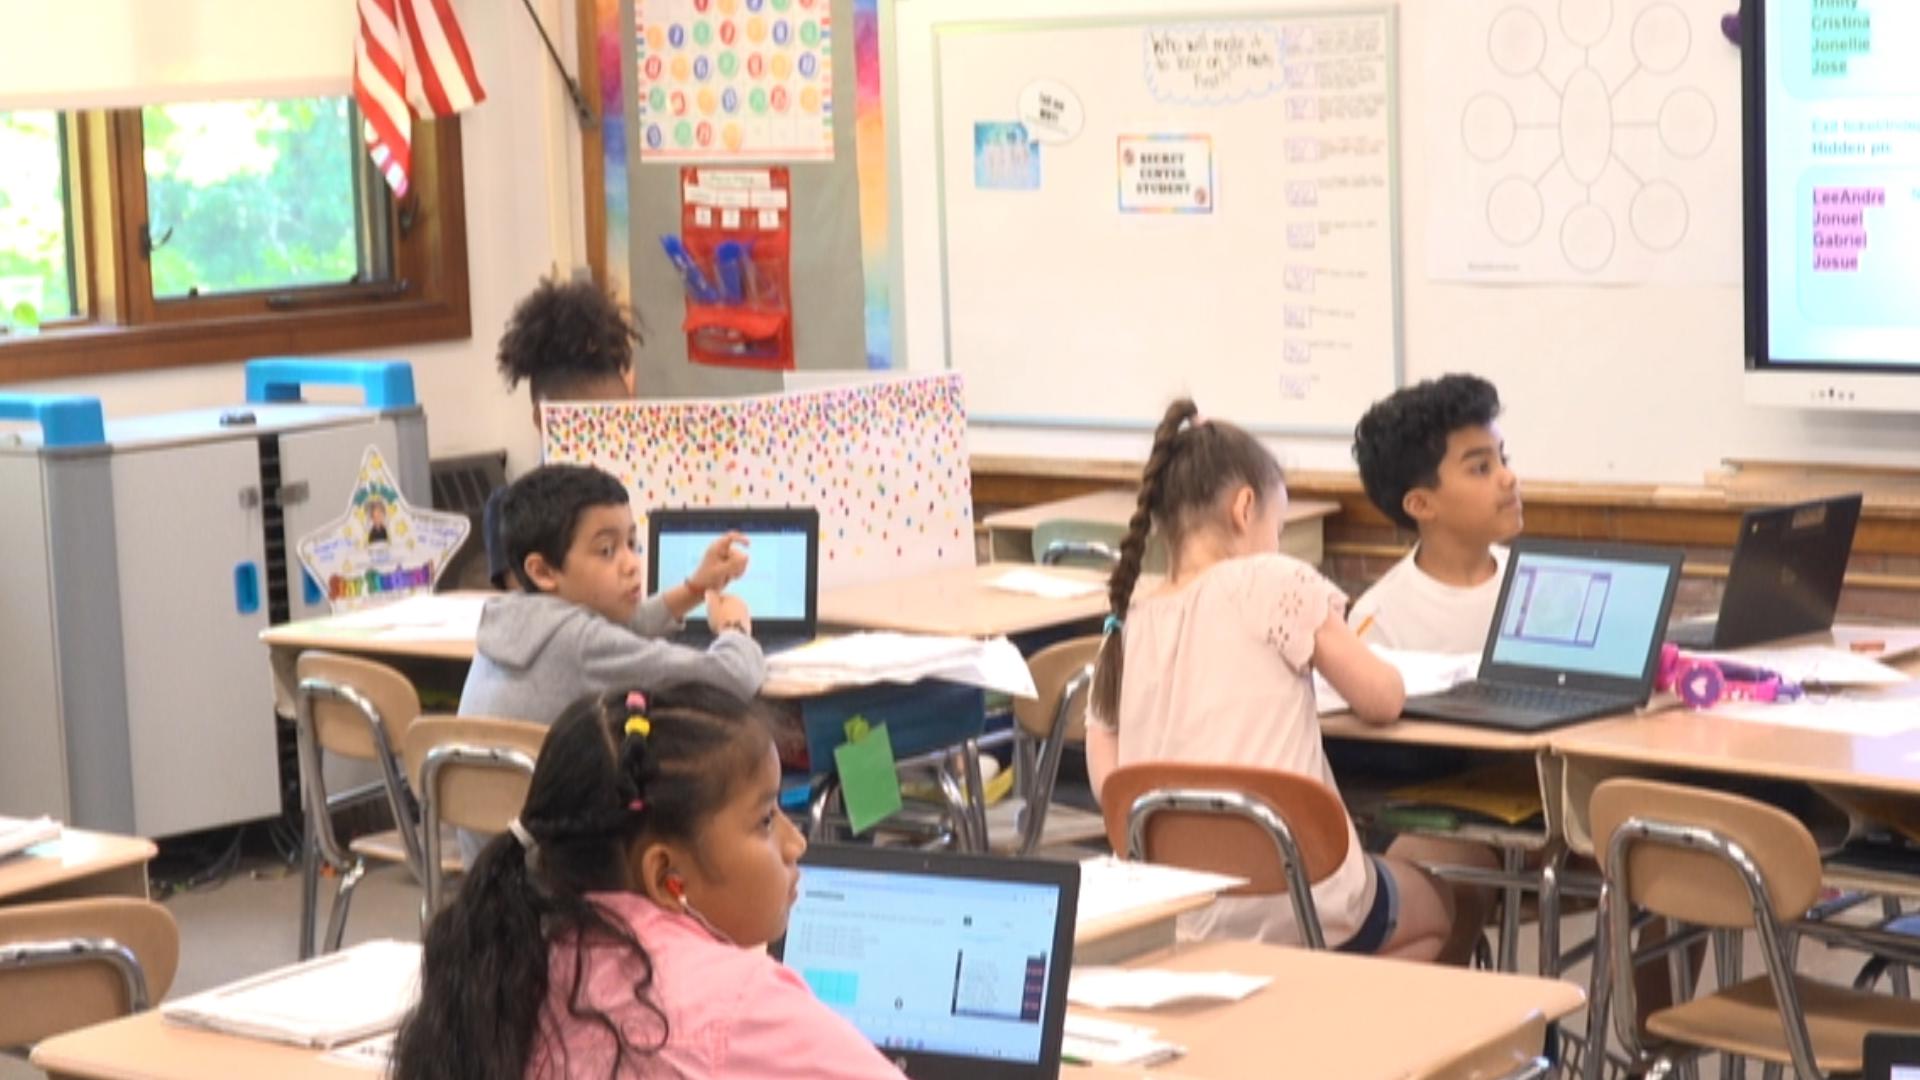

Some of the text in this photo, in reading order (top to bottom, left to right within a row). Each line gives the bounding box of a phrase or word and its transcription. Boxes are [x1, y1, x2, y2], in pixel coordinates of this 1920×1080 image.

[1811, 16, 1870, 30] Cristina
[1140, 151, 1185, 165] SECRET
[1139, 168, 1186, 180] CENTER
[1136, 181, 1191, 196] STUDENT
[1813, 189, 1885, 205] LeeAndre
[1813, 210, 1863, 226] Jonuel
[1813, 231, 1867, 248] Gabriel
[1813, 254, 1858, 269] Josue
